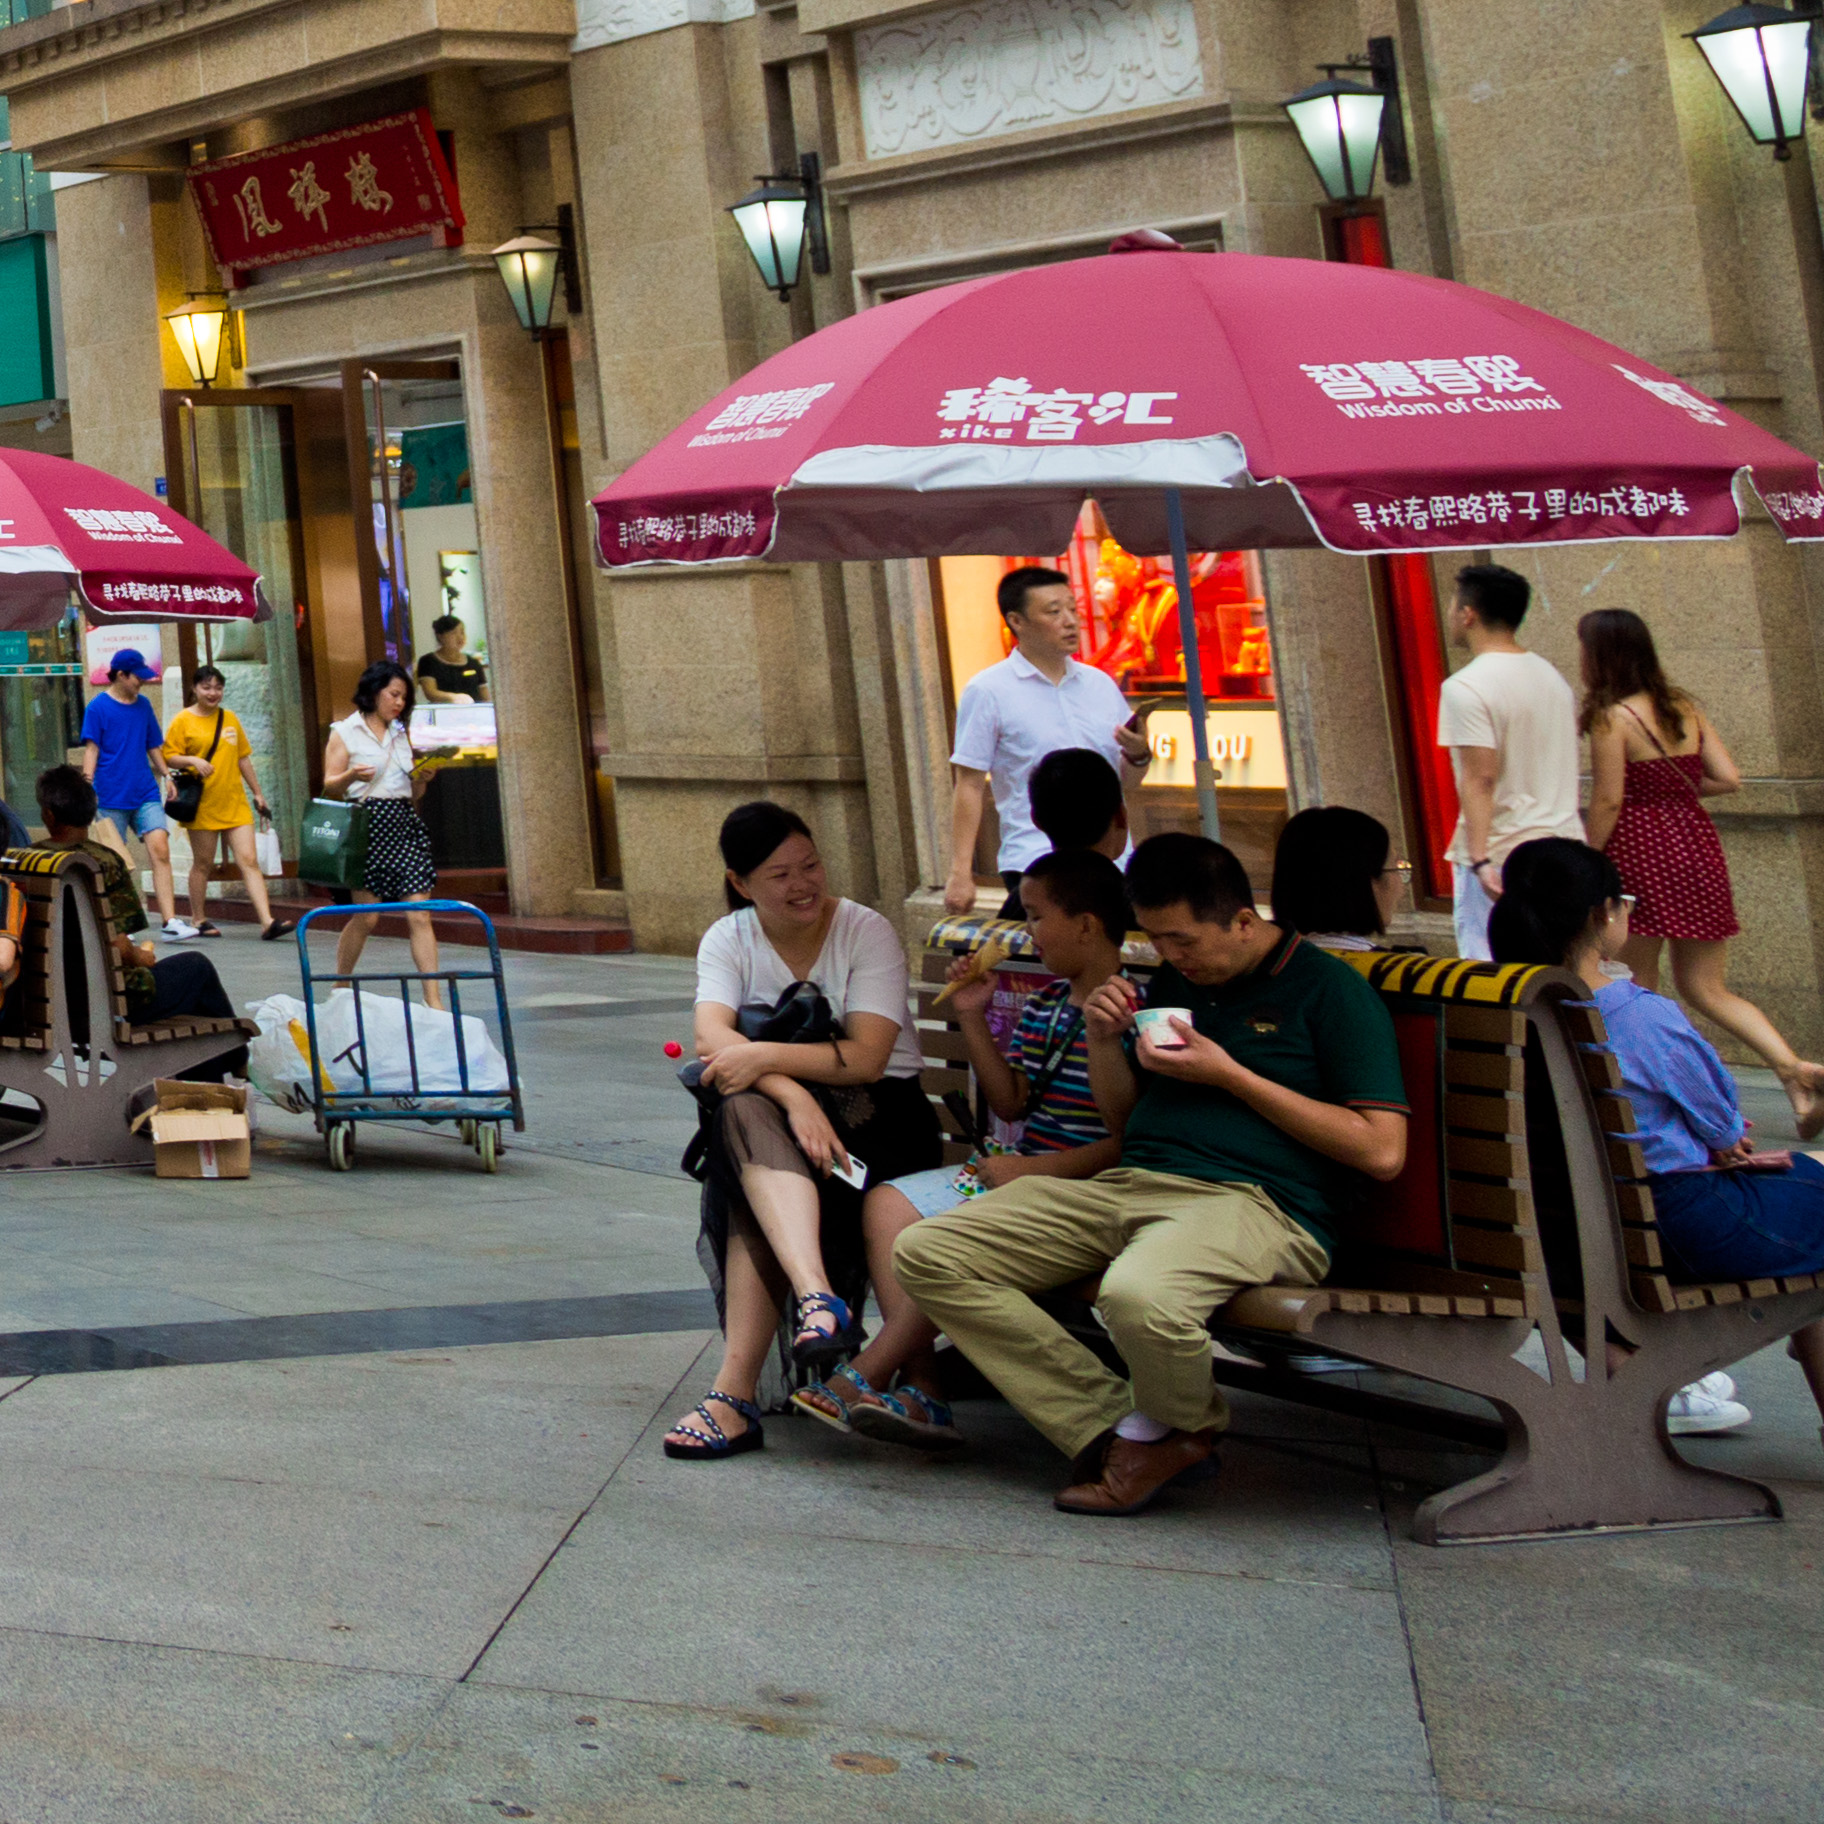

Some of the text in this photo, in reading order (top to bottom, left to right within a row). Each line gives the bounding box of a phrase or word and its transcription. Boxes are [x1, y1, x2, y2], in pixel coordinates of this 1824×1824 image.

[1299, 354, 1546, 400] 智慧春熙
[936, 376, 1178, 440] 稀客汇
[1337, 393, 1562, 420] Wisdom of Chunxi
